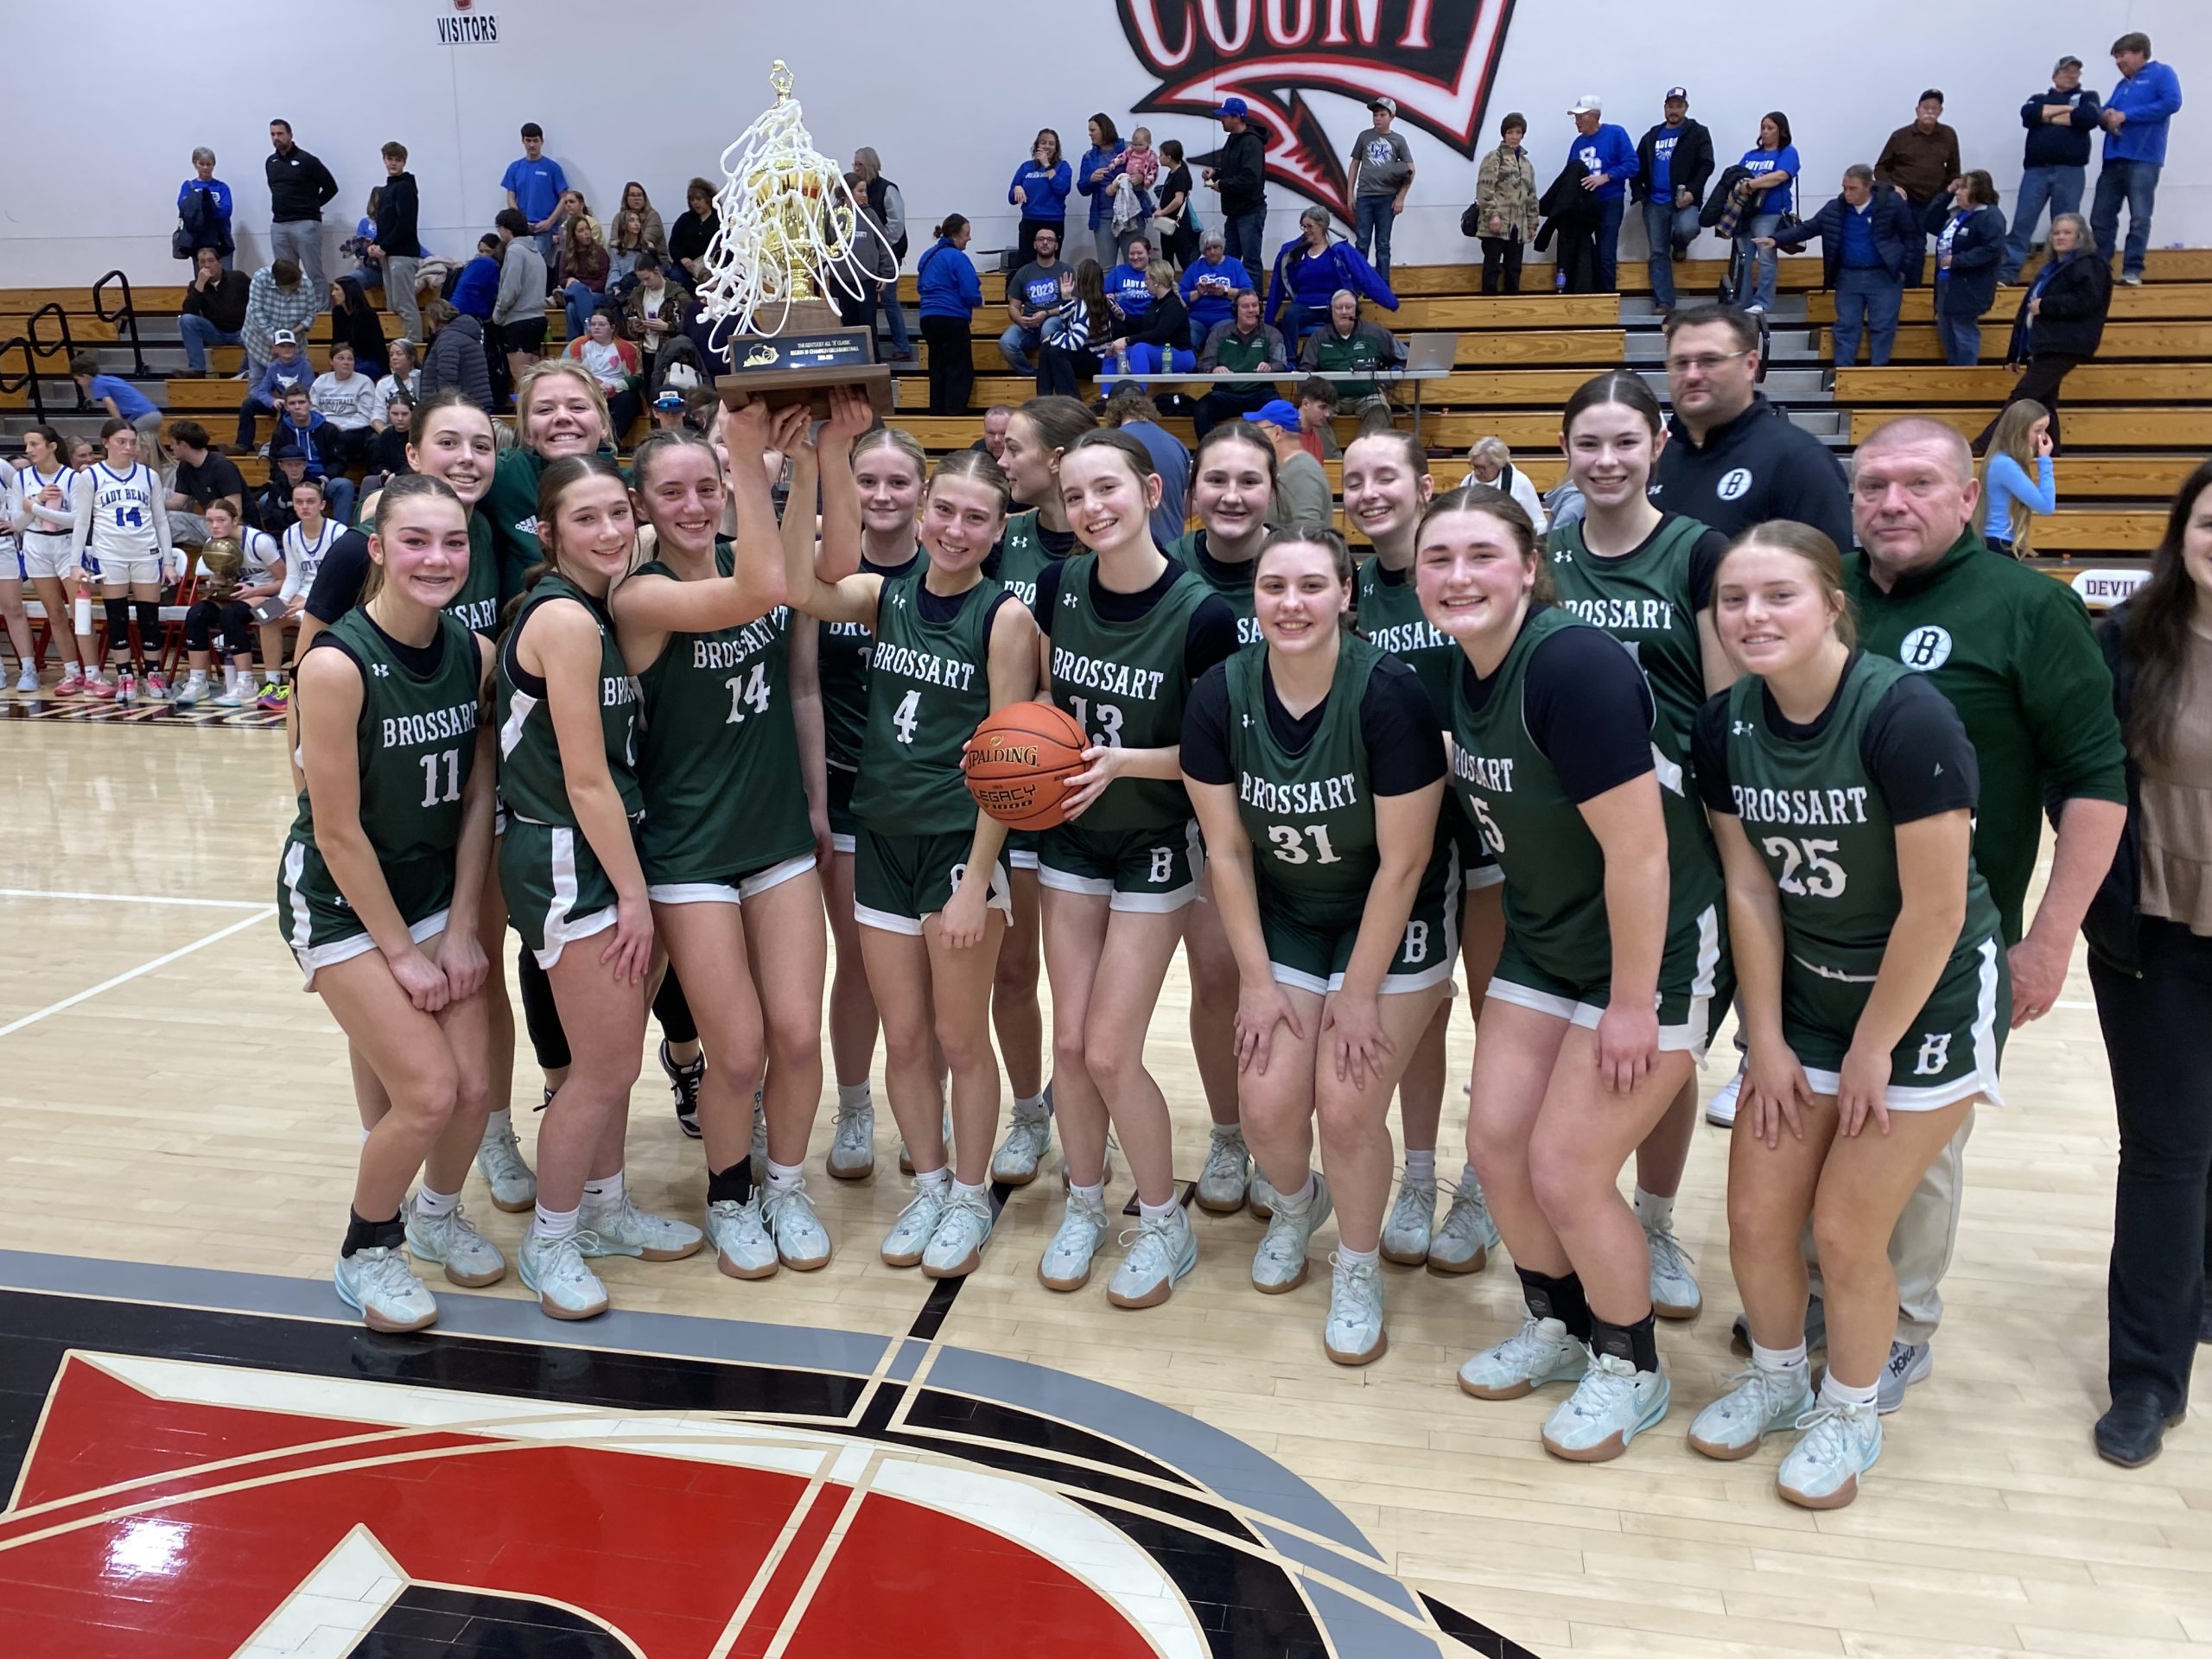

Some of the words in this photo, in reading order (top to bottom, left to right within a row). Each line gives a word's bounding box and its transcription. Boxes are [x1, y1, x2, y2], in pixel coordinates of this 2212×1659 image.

[436, 15, 498, 43] VISITORS
[1029, 281, 1054, 298] 2023
[1122, 277, 1141, 289] LADY
[100, 489, 122, 507] LADY
[1722, 471, 1745, 497] B
[116, 506, 143, 527] 14
[514, 523, 539, 536] adida
[2085, 580, 2136, 596] DEVIL
[873, 641, 976, 691] BROSSART
[1910, 630, 1941, 666] B
[725, 661, 772, 724] 14
[1052, 646, 1165, 701] BROSSART
[383, 700, 478, 748] BROSSART
[893, 690, 922, 744] 4
[1069, 695, 1124, 748] 13
[968, 745, 1039, 769] SPALDING
[419, 747, 461, 808] 11
[972, 784, 1036, 803] LEGACY
[1240, 771, 1357, 815] BROSSART
[1469, 794, 1506, 854] 5
[1731, 785, 1868, 824] BROSSART
[1268, 824, 1342, 865] 31
[1147, 847, 1173, 883] B
[1762, 836, 1848, 899] 25
[1402, 919, 1429, 963] B
[1912, 1033, 1953, 1075] B
[1888, 1345, 1916, 1378] HOKA
